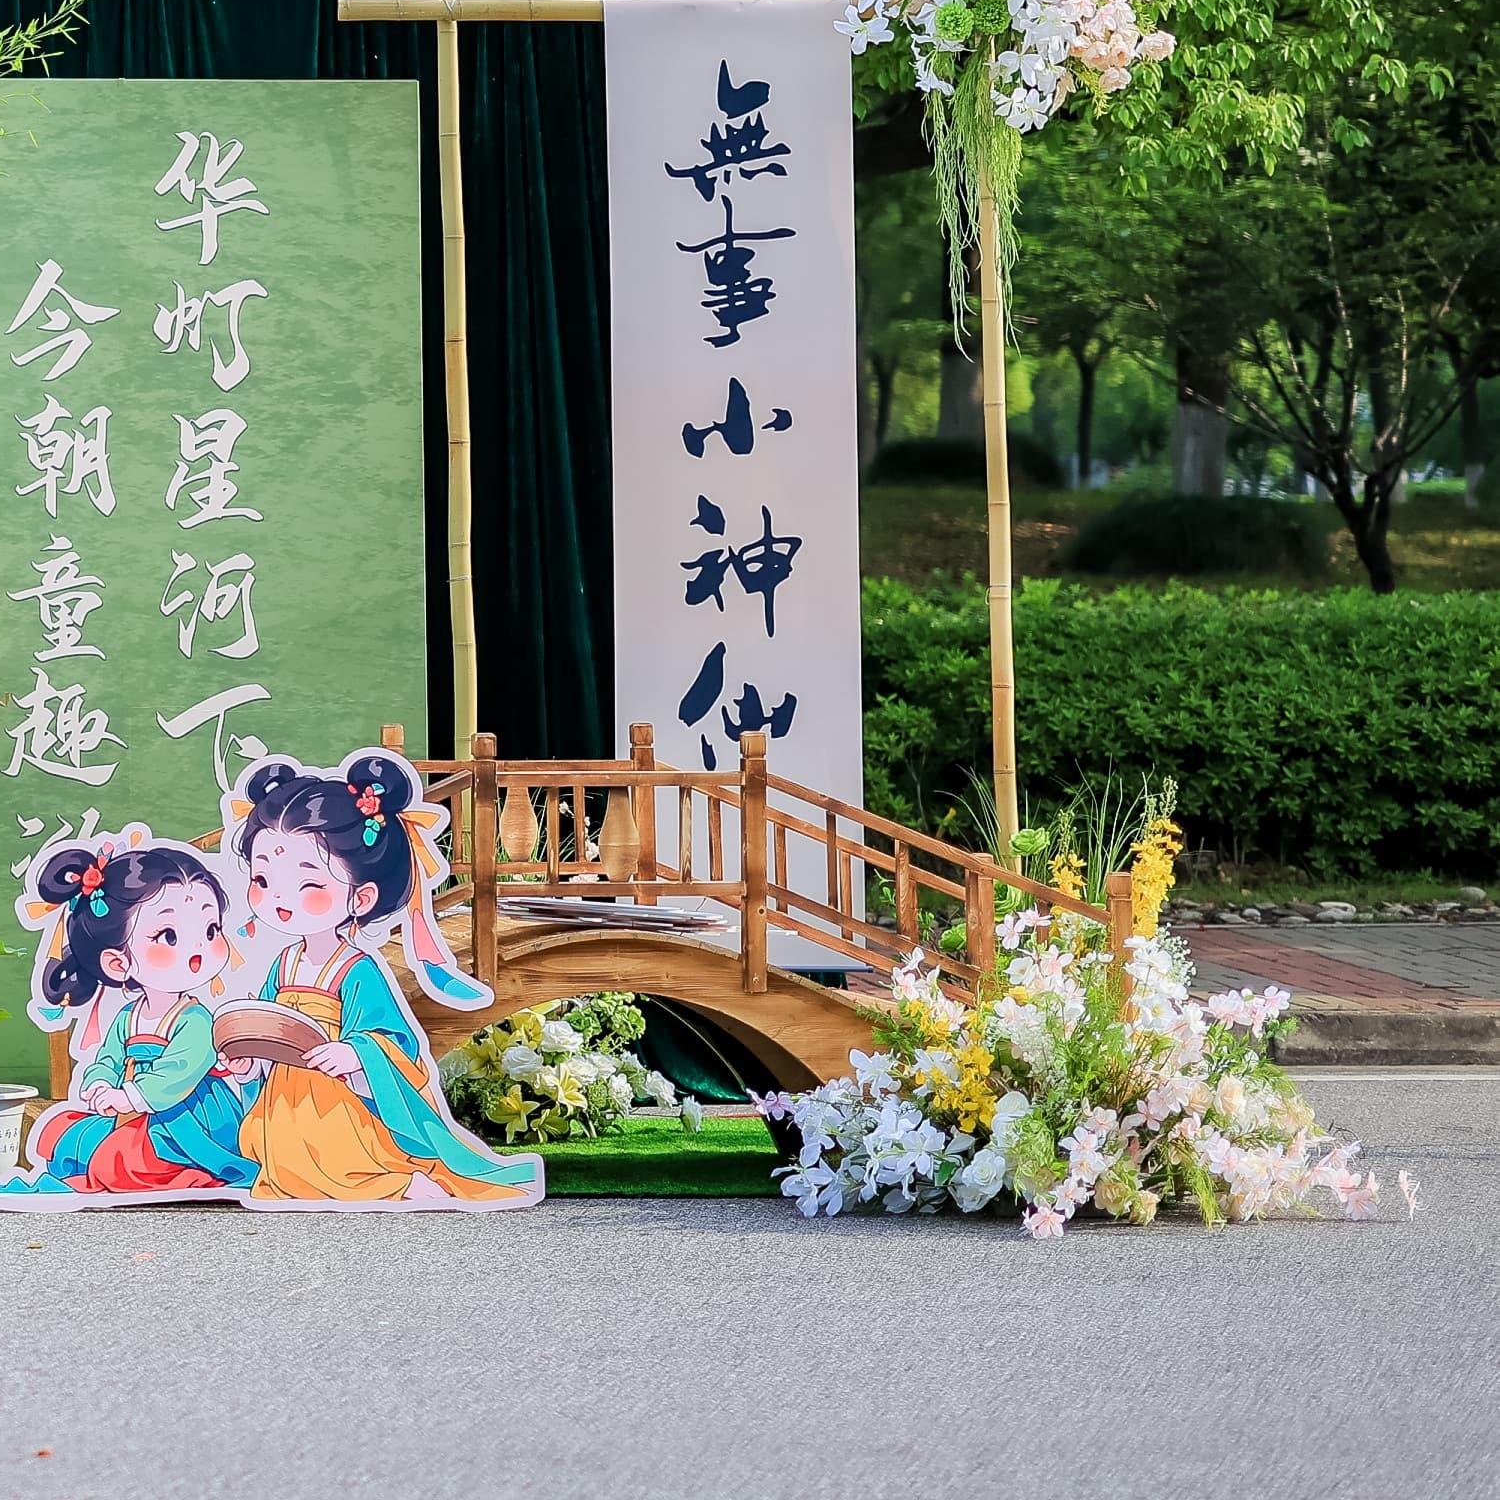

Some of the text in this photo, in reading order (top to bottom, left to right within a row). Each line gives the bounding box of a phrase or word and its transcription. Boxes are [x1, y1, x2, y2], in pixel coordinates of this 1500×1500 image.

[153, 130, 272, 794] 华灯星河下
